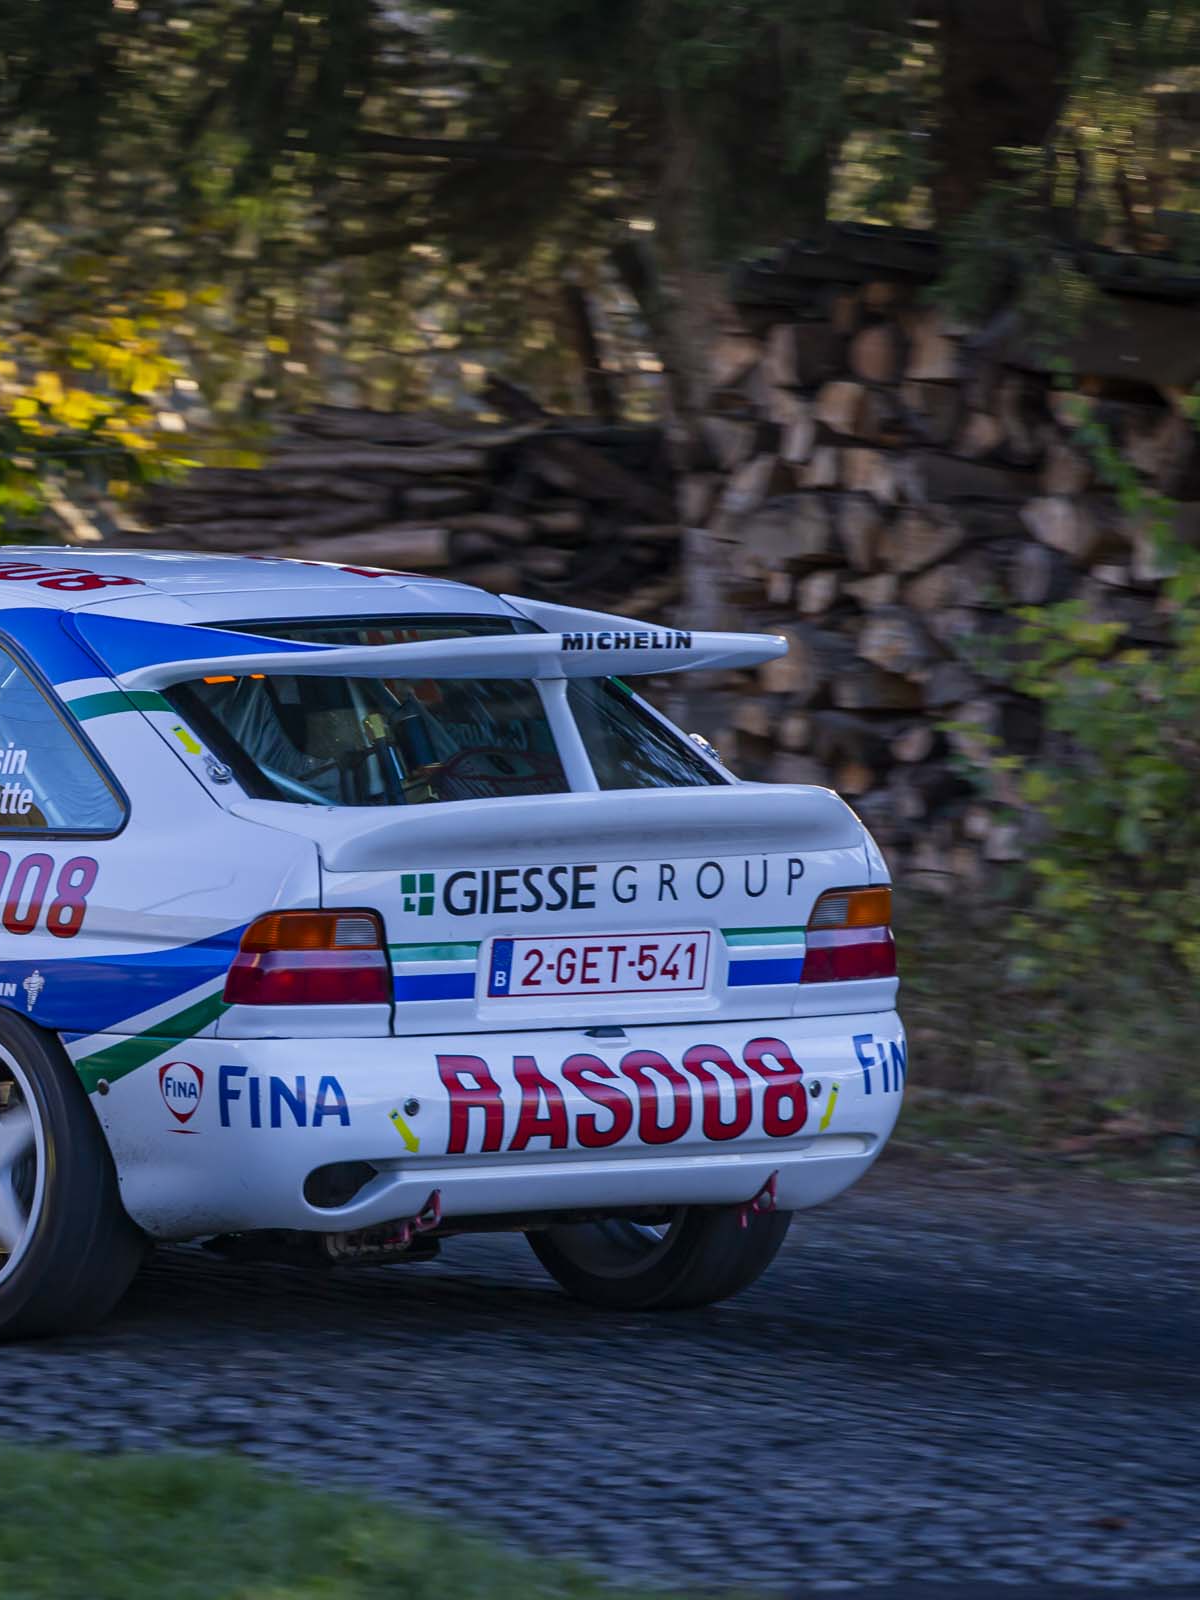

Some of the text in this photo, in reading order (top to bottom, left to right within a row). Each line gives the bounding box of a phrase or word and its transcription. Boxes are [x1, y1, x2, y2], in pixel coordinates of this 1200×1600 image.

[561, 632, 692, 650] MICHELIN
[443, 857, 806, 916] GIESSE GROUP
[495, 971, 506, 987] B
[521, 943, 697, 986] 2-GET-541
[165, 1077, 198, 1099] FINA
[218, 1065, 351, 1129] FINA
